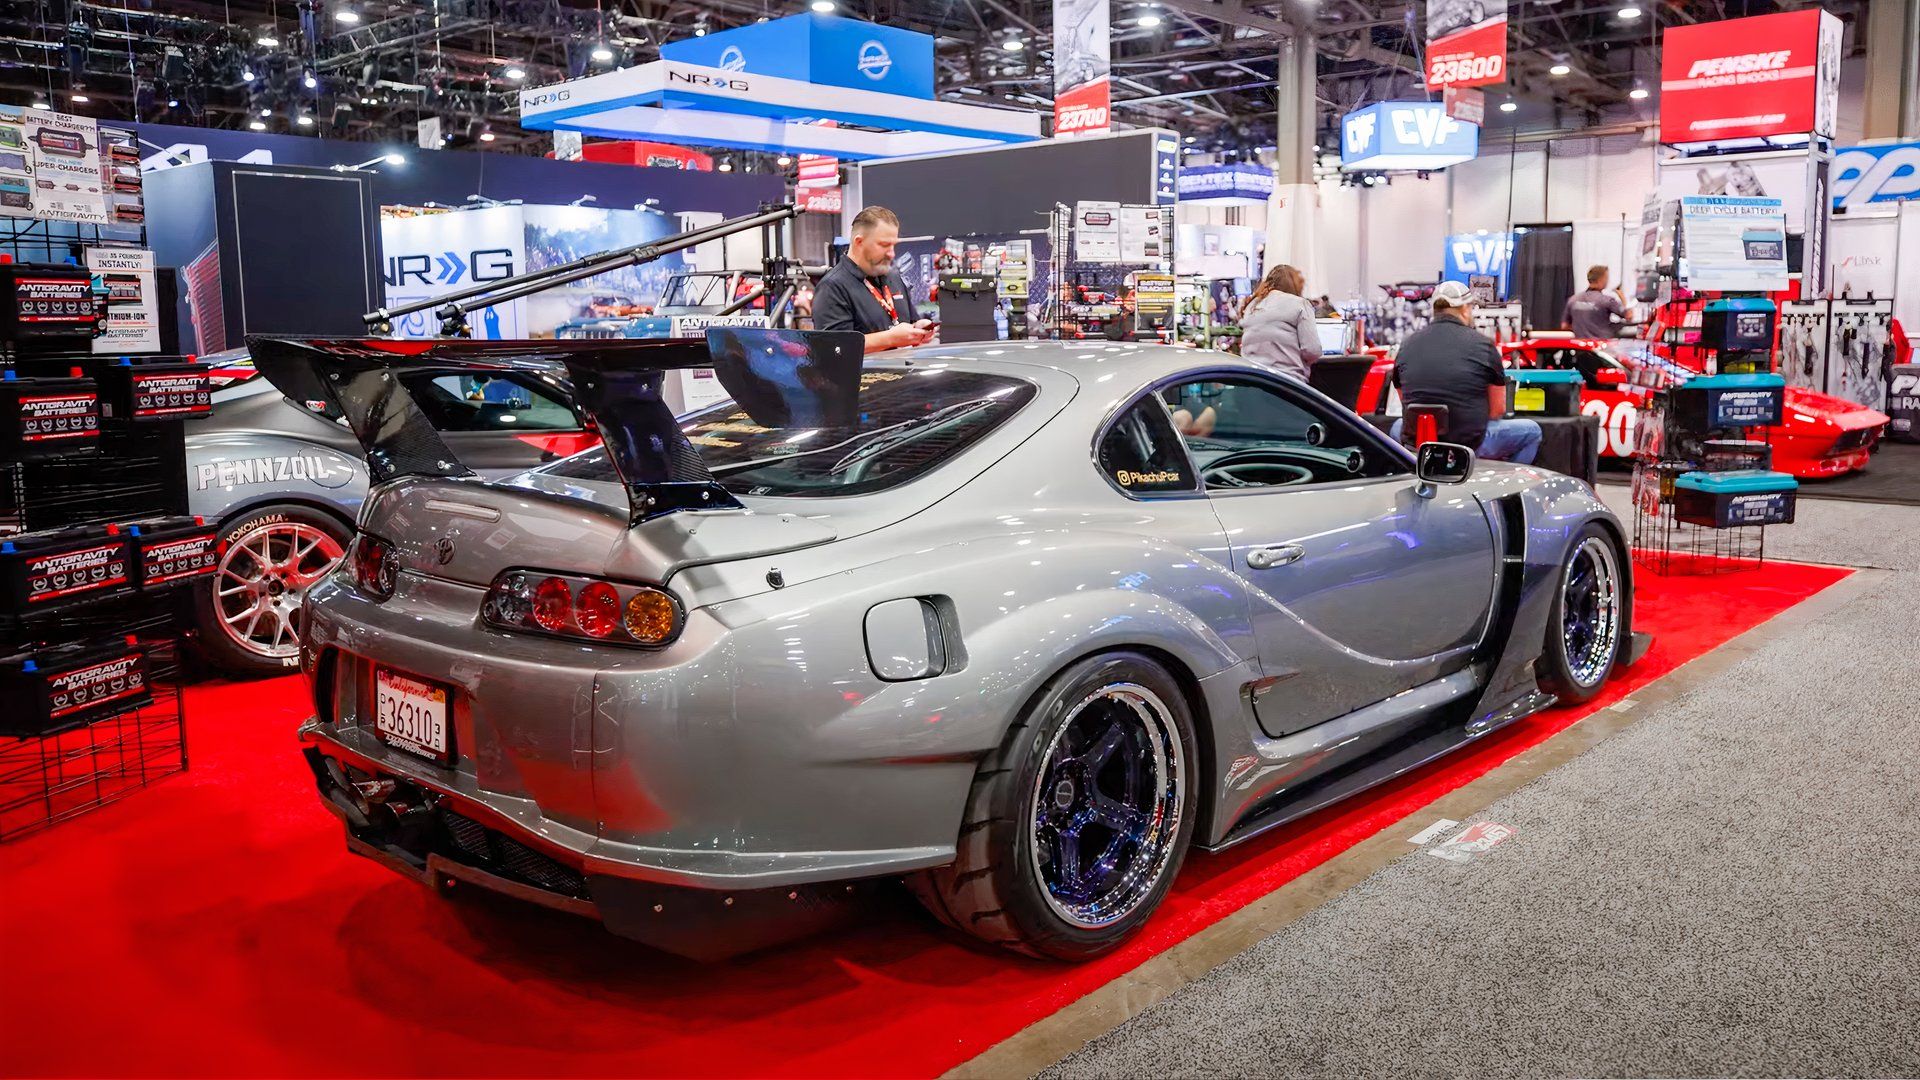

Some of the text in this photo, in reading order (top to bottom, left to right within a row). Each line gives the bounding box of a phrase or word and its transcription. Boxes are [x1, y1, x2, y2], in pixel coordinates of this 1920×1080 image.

[1429, 55, 1502, 85] 23600
[1688, 50, 1791, 78] PENSKE
[669, 71, 749, 92] NRG
[524, 89, 570, 108] NRG
[1058, 107, 1107, 130] 23700
[39, 209, 105, 220] ANTIGRAVITY
[18, 284, 90, 292] ANTIGRAVITY
[138, 377, 206, 388] ANTIGRAVITY
[149, 385, 197, 393] BATTERIES
[22, 399, 95, 411] ANTIGRAVITY
[34, 407, 87, 417] BATTERIES
[197, 456, 332, 490] PENNZOIL
[226, 514, 283, 544] YOKOHAMA
[147, 539, 213, 557] ANTIGRAVITY
[32, 548, 118, 571] ANTIGRAVITY
[53, 658, 137, 688] ANTIGRAVITY
[388, 696, 432, 745] 36310
